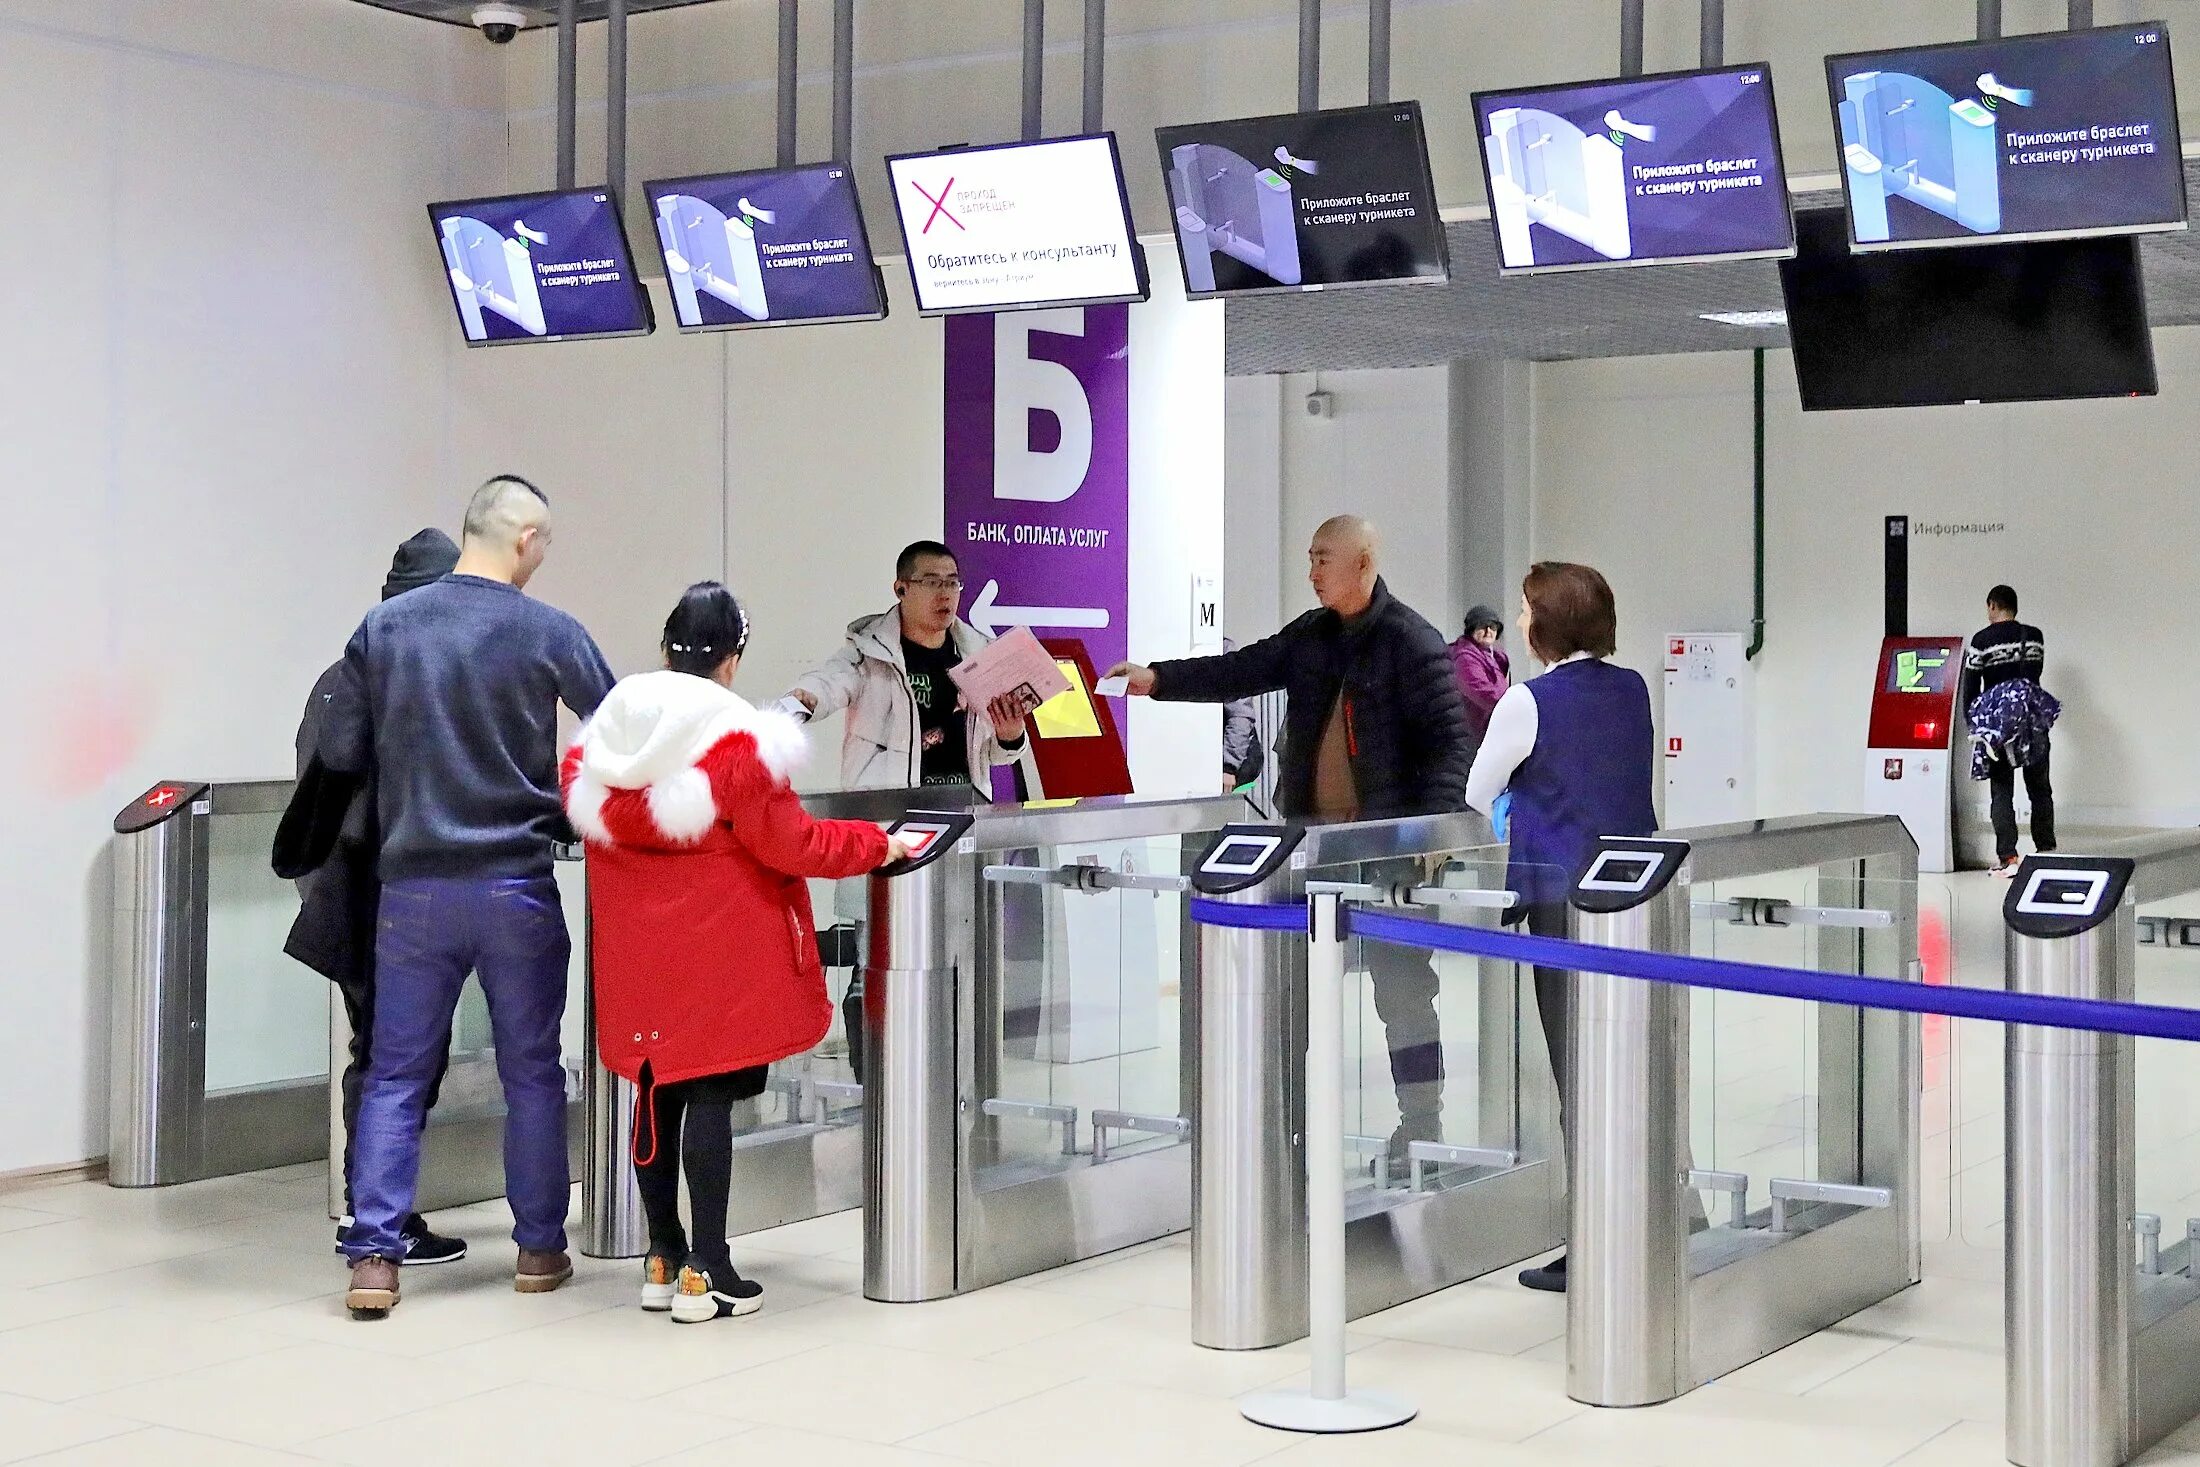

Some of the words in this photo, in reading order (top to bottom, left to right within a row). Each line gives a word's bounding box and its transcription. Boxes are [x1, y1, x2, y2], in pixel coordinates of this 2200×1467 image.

[2006, 128, 2087, 149] Приложите
[2090, 124, 2149, 142] браслет
[2009, 154, 2018, 165] к
[2019, 148, 2077, 164] сканеру
[2080, 142, 2154, 162] турникета
[1632, 163, 1704, 181] Приложите
[1705, 159, 1758, 175] браслет
[957, 189, 997, 201] ПРОХОД
[1635, 185, 1644, 196] к
[1645, 180, 1696, 195] сканеру
[1697, 175, 1763, 193] турникета
[960, 201, 1015, 214] ЗАПРЕЩЕН
[1300, 196, 1364, 212] Приложите
[1365, 191, 1411, 206] браслет
[1304, 216, 1312, 226] к
[1312, 212, 1357, 225] сканеру
[1359, 207, 1416, 223] турникета
[762, 242, 812, 256] Приложите
[812, 238, 848, 252] браслет
[928, 252, 1007, 271] Обратитесь
[1011, 252, 1019, 262] к
[1023, 243, 1117, 262] консультанту
[537, 260, 582, 275] Приложите
[582, 258, 615, 272] браслет
[765, 259, 773, 269] к
[773, 256, 808, 268] сканеру
[808, 252, 854, 266] турникета
[541, 278, 548, 287] к
[547, 275, 579, 287] сканеру
[579, 272, 620, 285] турникета
[993, 306, 1094, 503] Б
[967, 522, 1011, 547] БАНК,
[1014, 524, 1067, 546] ОПЛАТА
[1069, 527, 1110, 549] УСЛУГ
[1914, 522, 2004, 538] Информация
